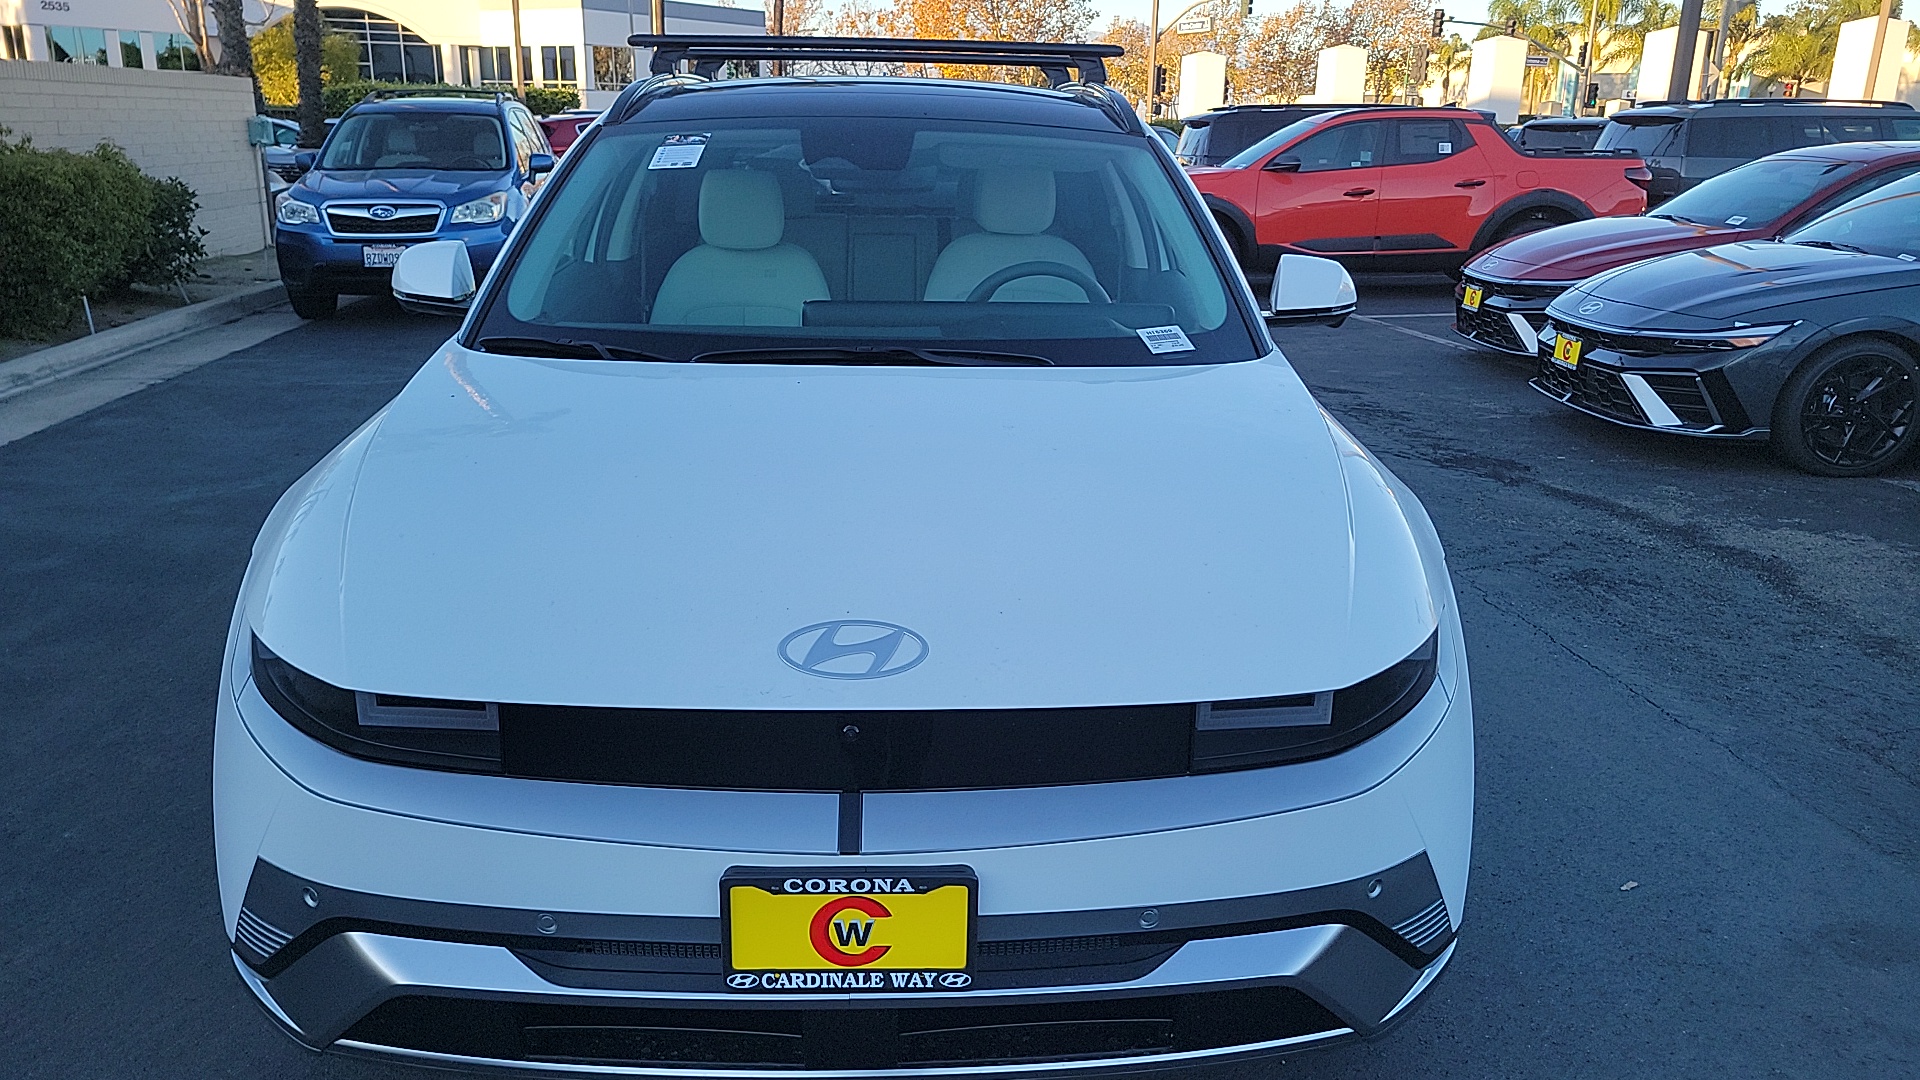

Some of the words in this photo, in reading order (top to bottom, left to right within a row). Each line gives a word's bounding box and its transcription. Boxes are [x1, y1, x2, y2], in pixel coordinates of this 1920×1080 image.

[40, 0, 70, 12] 2535
[783, 878, 915, 893] CORONA
[761, 972, 885, 989] CARDINALE
[891, 972, 938, 989] WAY
